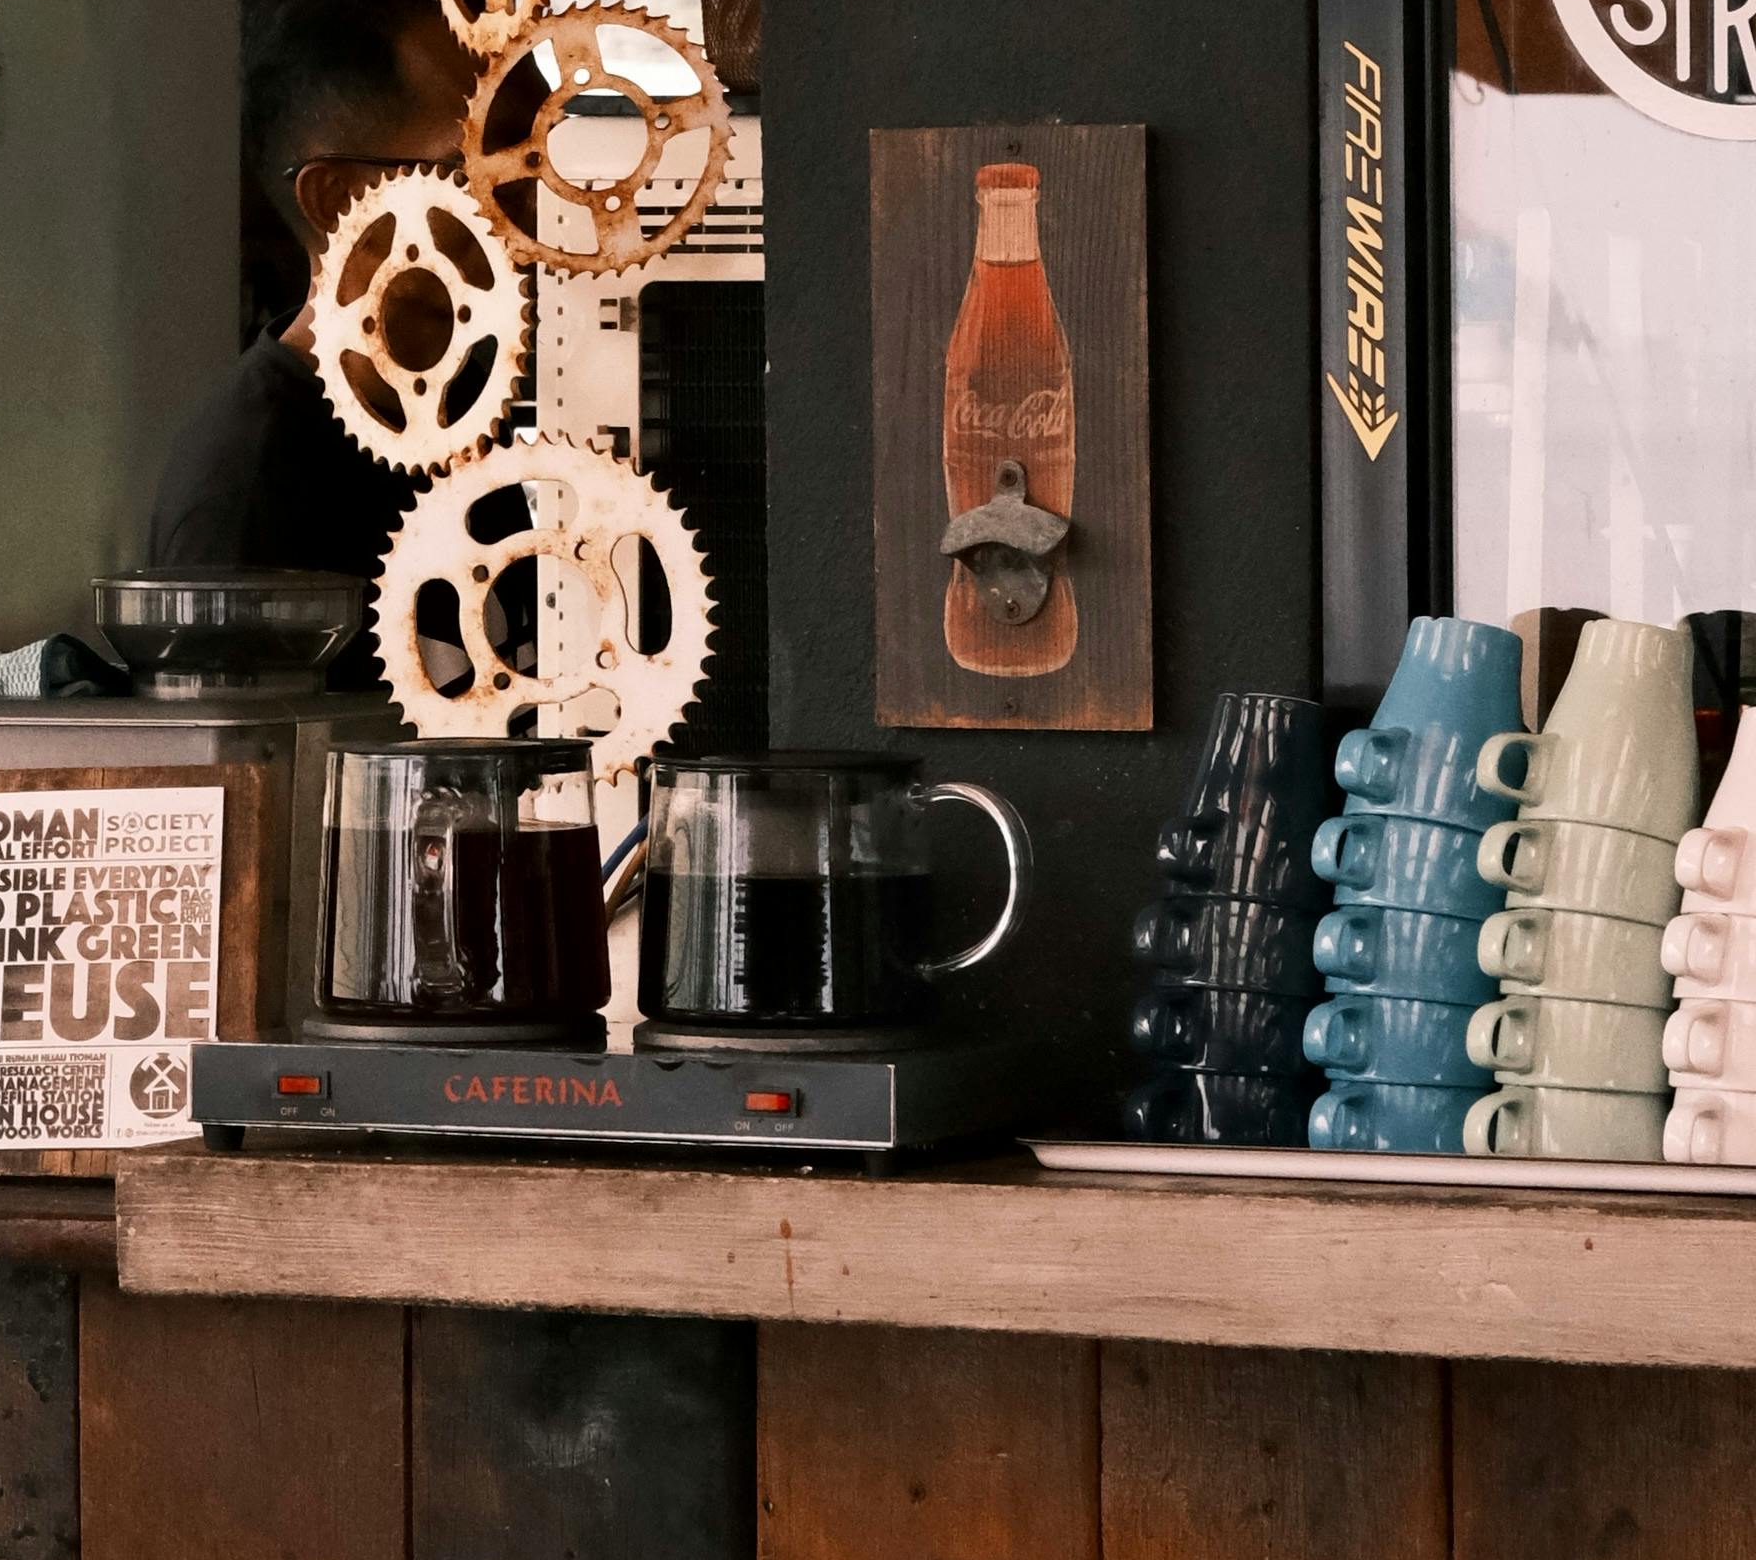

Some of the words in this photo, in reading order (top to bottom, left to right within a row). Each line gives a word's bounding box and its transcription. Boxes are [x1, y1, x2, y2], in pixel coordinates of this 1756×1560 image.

[1343, 40, 1386, 390] FIREWIRE
[106, 812, 214, 834] SOCIETY
[21, 838, 98, 860] EFFORT
[104, 835, 214, 854] PROJECT
[73, 863, 214, 891] EVERYDAY
[16, 888, 178, 927] PLASTIC
[76, 924, 212, 961] GREEN
[69, 1052, 107, 1062] TIOMAN
[0, 1065, 59, 1076] RESEARCH
[61, 1064, 106, 1076] CENTRE
[41, 1089, 105, 1105] STATION
[444, 1073, 624, 1108] CAFERINA
[21, 1103, 105, 1126] HOUSE
[280, 1106, 300, 1117] OFF
[320, 1107, 336, 1118] ON
[45, 1126, 104, 1139] WORKS
[734, 1120, 751, 1131] ON
[775, 1122, 795, 1133] OFF
